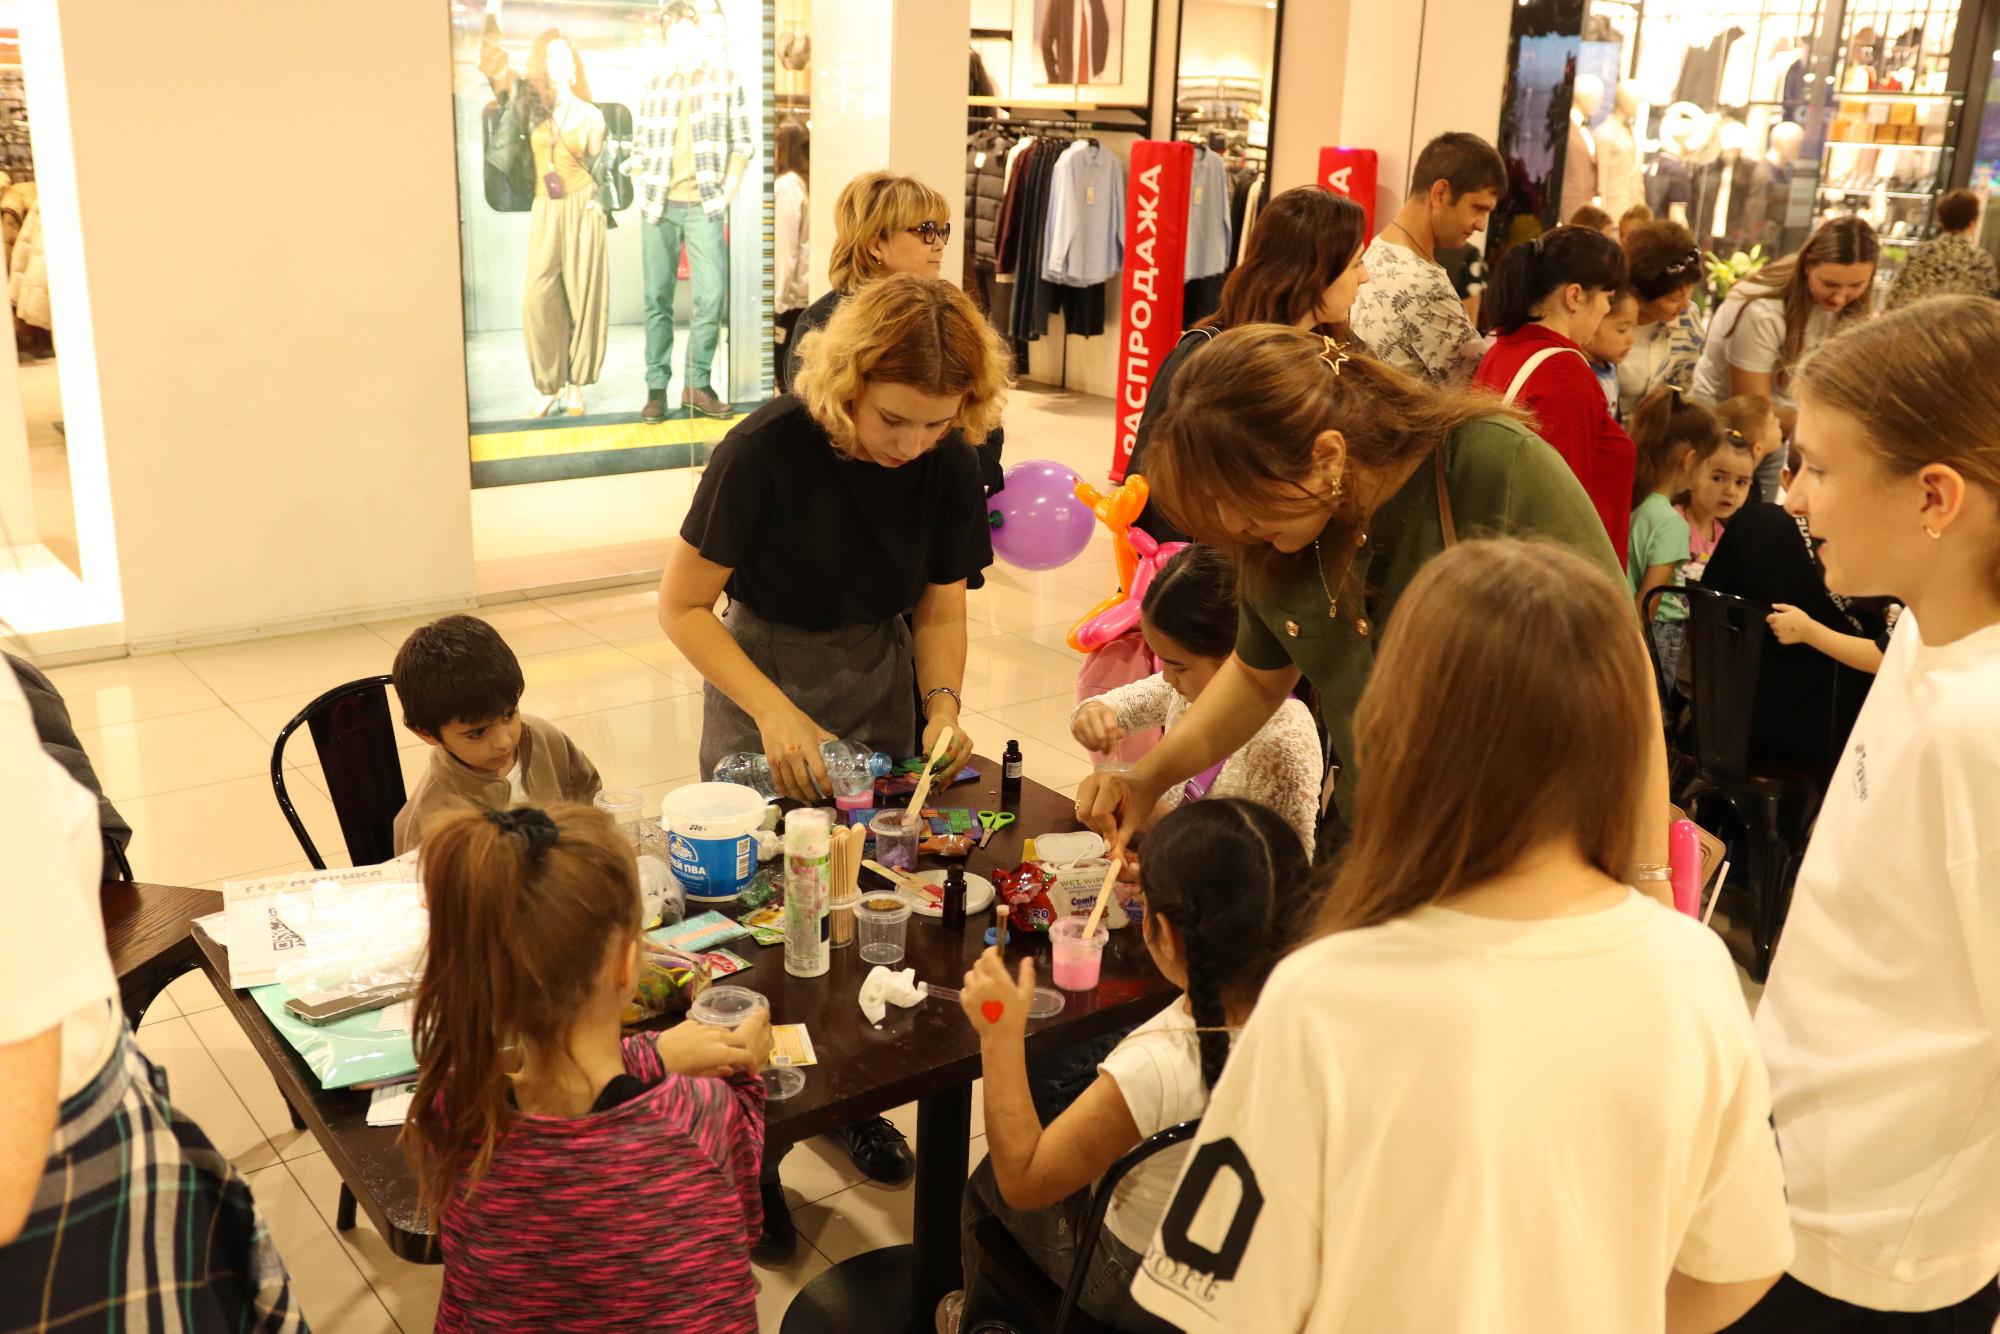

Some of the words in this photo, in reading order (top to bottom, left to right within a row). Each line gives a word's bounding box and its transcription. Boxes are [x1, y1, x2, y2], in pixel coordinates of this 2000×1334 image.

[1122, 163, 1163, 457] РАСПРОДАЖА
[684, 864, 706, 877] ПВА
[1033, 909, 1049, 919] 20
[1144, 1240, 1220, 1302] ort
